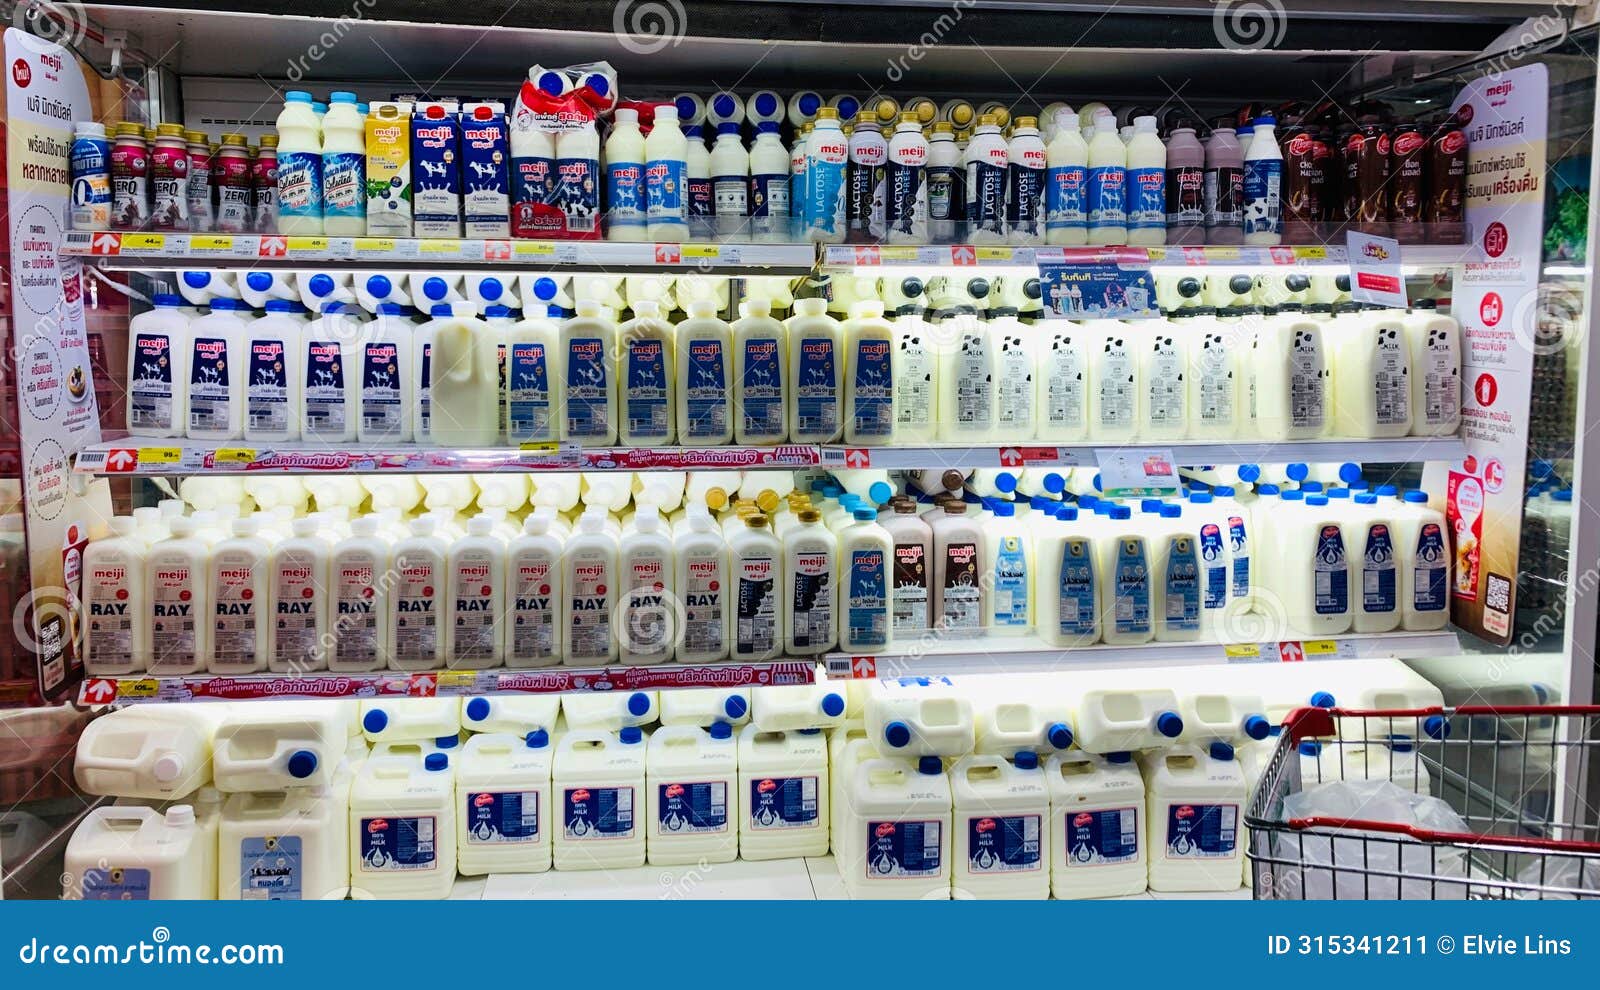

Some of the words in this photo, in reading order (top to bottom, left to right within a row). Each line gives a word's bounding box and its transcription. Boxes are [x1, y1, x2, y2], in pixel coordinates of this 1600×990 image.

[41, 54, 62, 72] meiji
[1487, 80, 1512, 97] meiji
[374, 128, 400, 139] meiji
[416, 127, 452, 142] meiji
[465, 129, 501, 143] meiji
[820, 144, 847, 157] meiji
[856, 144, 885, 157] meiji
[898, 146, 926, 158] meiji
[520, 162, 548, 175] meiji
[560, 163, 588, 176] meiji
[613, 167, 639, 179] meiji
[1056, 171, 1083, 183] meiji
[816, 166, 825, 213] LACTOSE
[853, 169, 862, 216] LACTOSE
[894, 170, 904, 216] LACTOSE
[985, 170, 995, 216] LACTOSE
[1019, 172, 1028, 217] LACTOSE
[138, 337, 167, 351] meiji
[196, 342, 225, 354] meiji
[253, 343, 281, 355] meiji
[572, 343, 602, 356] meiji
[631, 343, 661, 356] meiji
[692, 343, 720, 355] meiji
[748, 342, 777, 355] meiji
[803, 343, 831, 355] meiji
[860, 343, 889, 355] meiji
[310, 345, 340, 357] meiji
[366, 346, 395, 358] meiji
[514, 347, 543, 360] meiji
[896, 546, 923, 558] meiji
[948, 546, 975, 558] meiji
[799, 556, 826, 568] meiji
[855, 554, 882, 567] meiji
[94, 567, 124, 580] meiji
[221, 568, 250, 580] meiji
[282, 567, 311, 580] meiji
[461, 565, 489, 577] meiji
[520, 564, 547, 576] meiji
[576, 564, 603, 576] meiji
[633, 563, 660, 575] meiji
[689, 562, 717, 574] meiji
[744, 562, 770, 574] meiji
[158, 569, 188, 582] meiji
[398, 600, 433, 612] RAY
[456, 599, 490, 612] RAY
[516, 598, 549, 610] RAY
[572, 598, 606, 610] RAY
[630, 596, 662, 608] RAY
[686, 594, 718, 607] RAY
[90, 602, 128, 615] RAY
[154, 604, 191, 617] RAY
[216, 602, 252, 615] RAY
[277, 601, 313, 614] RAY
[338, 602, 372, 614] RAY
